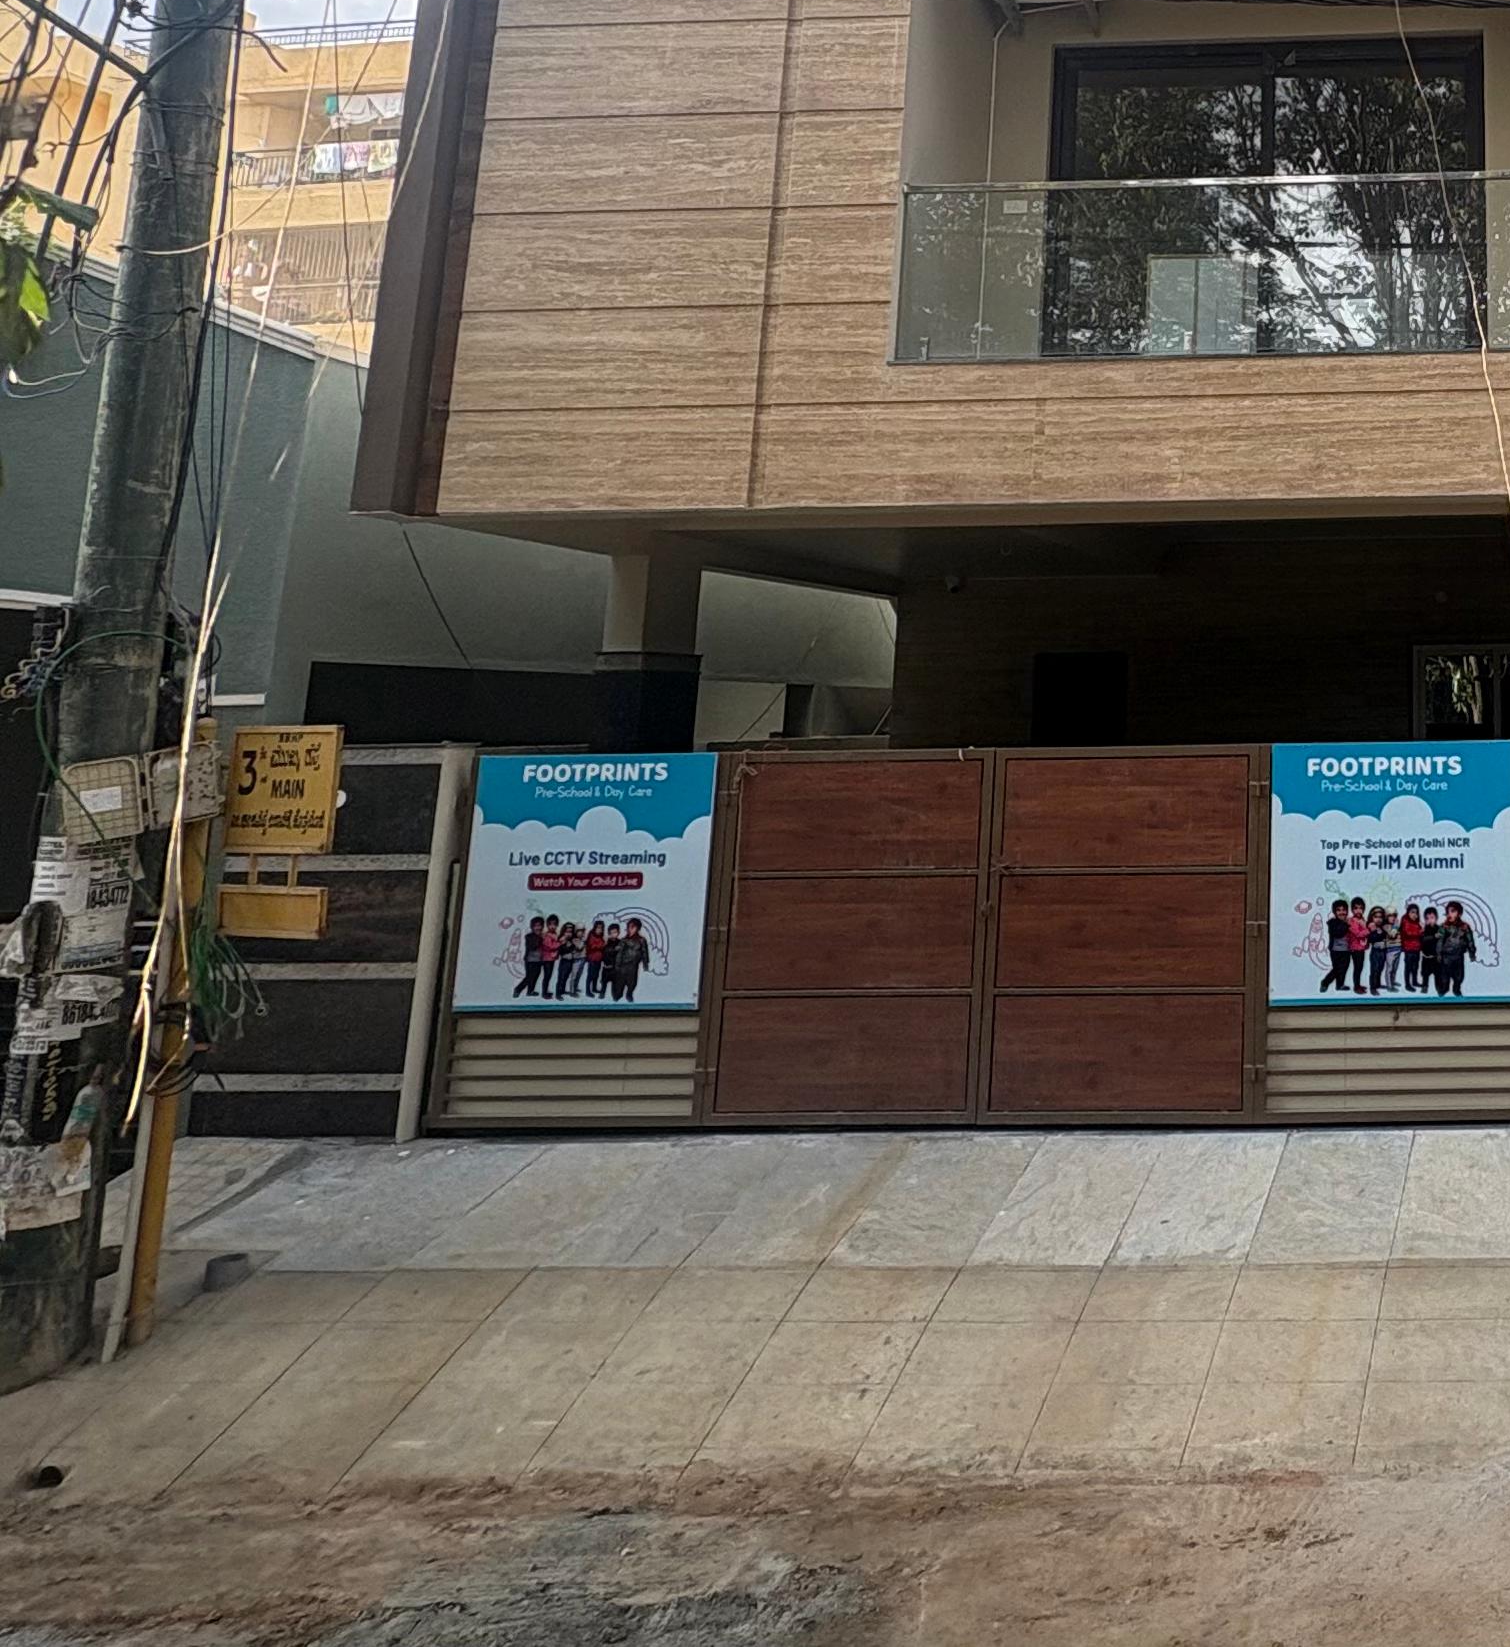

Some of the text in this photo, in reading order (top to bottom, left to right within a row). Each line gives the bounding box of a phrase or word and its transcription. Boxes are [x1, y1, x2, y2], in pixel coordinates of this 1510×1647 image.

[238, 750, 257, 795] 3
[522, 762, 668, 783] FOOTPRINTS
[1307, 756, 1462, 777] FOOTPRINTS
[270, 779, 305, 799] MAIN
[535, 785, 593, 798] Pre-School
[605, 785, 624, 800] Day
[628, 784, 652, 797] Care
[1321, 778, 1448, 794] Pre-School & Day Care
[1320, 837, 1470, 851] Top Pre-School of Delhi NCR
[508, 849, 667, 867] Live CCTV Streaming
[1326, 853, 1464, 874] By IIT-IIM Alumni
[533, 876, 638, 887] Watch Your Child Live
